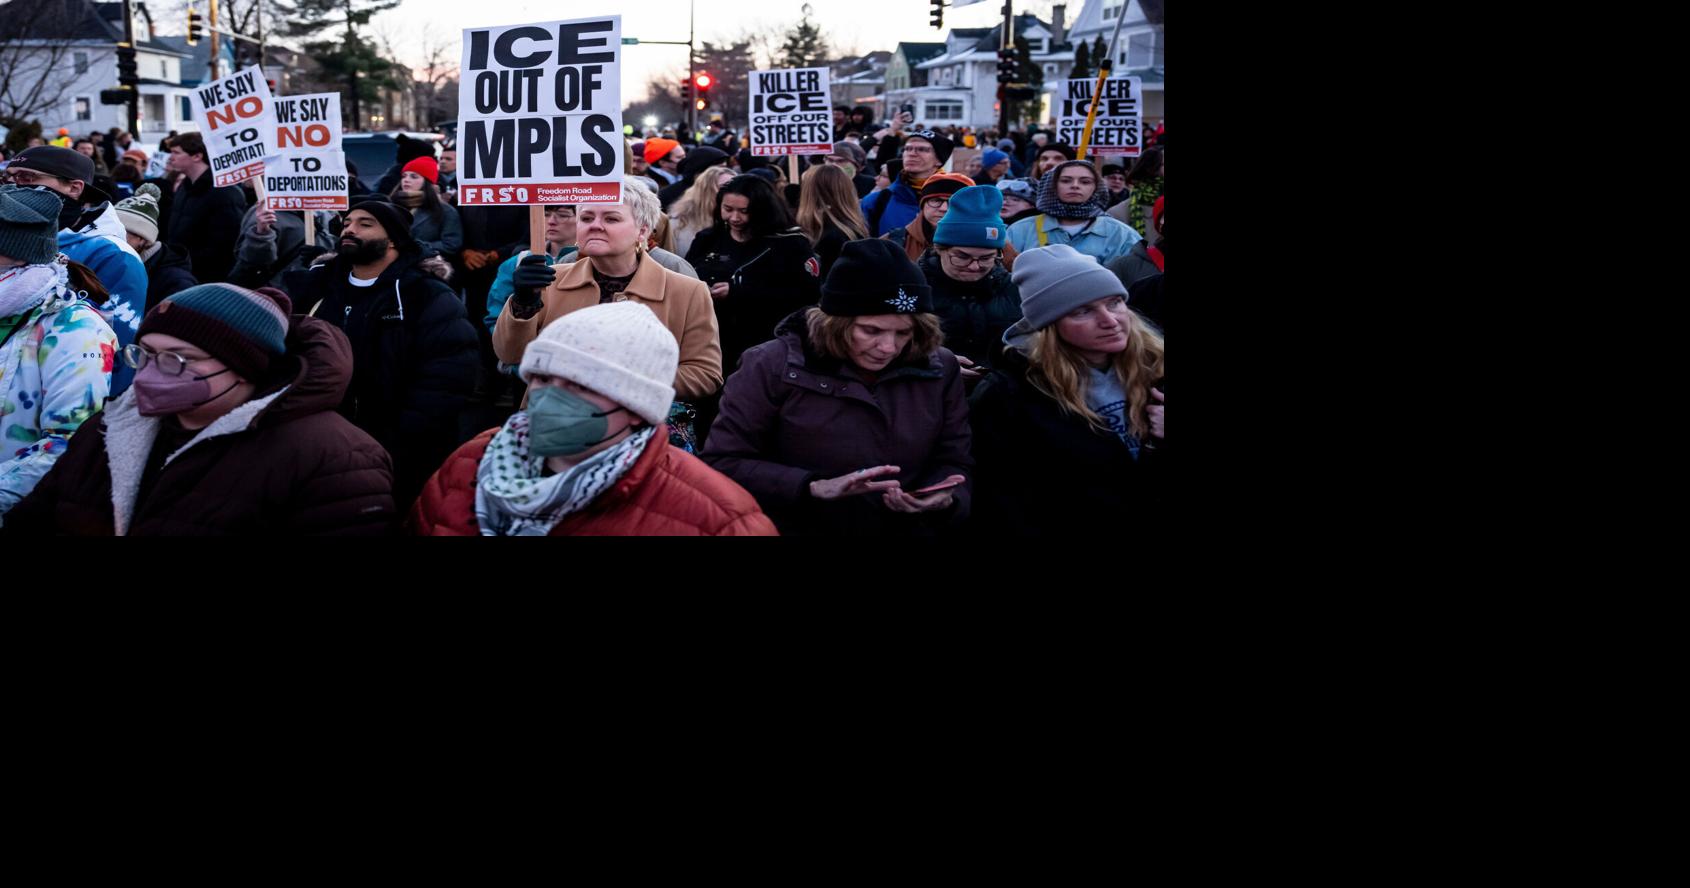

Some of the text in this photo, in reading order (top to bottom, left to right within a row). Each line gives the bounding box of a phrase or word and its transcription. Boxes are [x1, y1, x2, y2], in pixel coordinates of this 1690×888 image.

[469, 20, 615, 70] ICE
[199, 72, 256, 109] WE SAY
[475, 65, 603, 114] OUT OF
[759, 71, 819, 93] KILLER
[274, 98, 329, 123] WE SAY
[754, 92, 828, 113] ICE
[1063, 99, 1137, 117] ICE
[206, 96, 263, 131] NO
[753, 113, 829, 123] OFF OUR
[1062, 119, 1137, 127] OF OUR
[225, 128, 259, 147] TO
[277, 124, 331, 148] NO
[753, 123, 829, 144] STREETS
[464, 114, 616, 179] MPLS
[290, 157, 322, 172] TO
[217, 167, 249, 186] FRSO
[267, 176, 346, 192] DEPORTATIONS
[465, 187, 529, 203] FRSO
[537, 187, 571, 195] Freedom
[537, 194, 617, 202] Socialist Organization
[269, 198, 302, 208] FRSO
